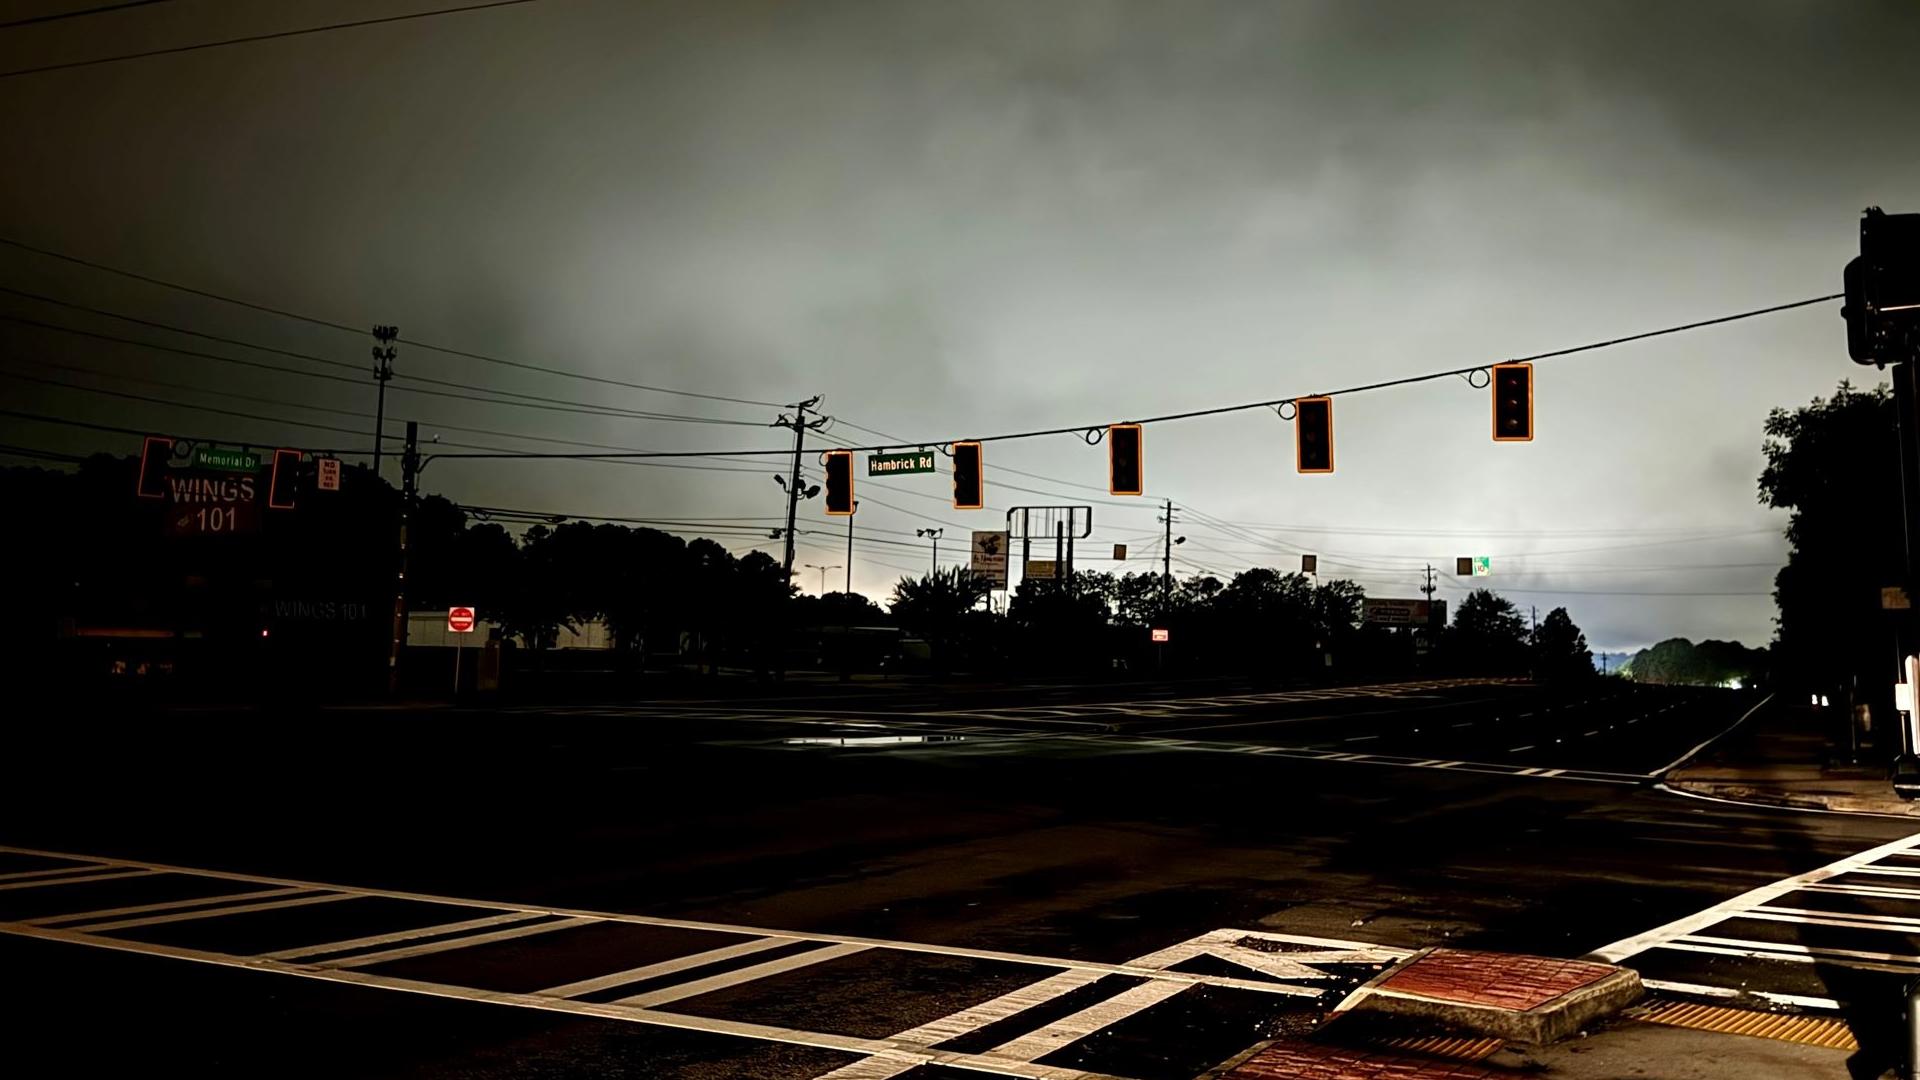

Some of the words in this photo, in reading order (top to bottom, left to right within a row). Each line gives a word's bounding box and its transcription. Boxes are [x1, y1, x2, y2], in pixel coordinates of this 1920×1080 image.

[199, 452, 242, 467] Memorial
[245, 456, 256, 468] Dr
[870, 458, 915, 472] Hambrick
[919, 456, 932, 469] Rd
[171, 477, 255, 503] WINGS
[196, 507, 236, 532] 101
[273, 600, 336, 620] WINGS
[341, 601, 368, 621] 101
